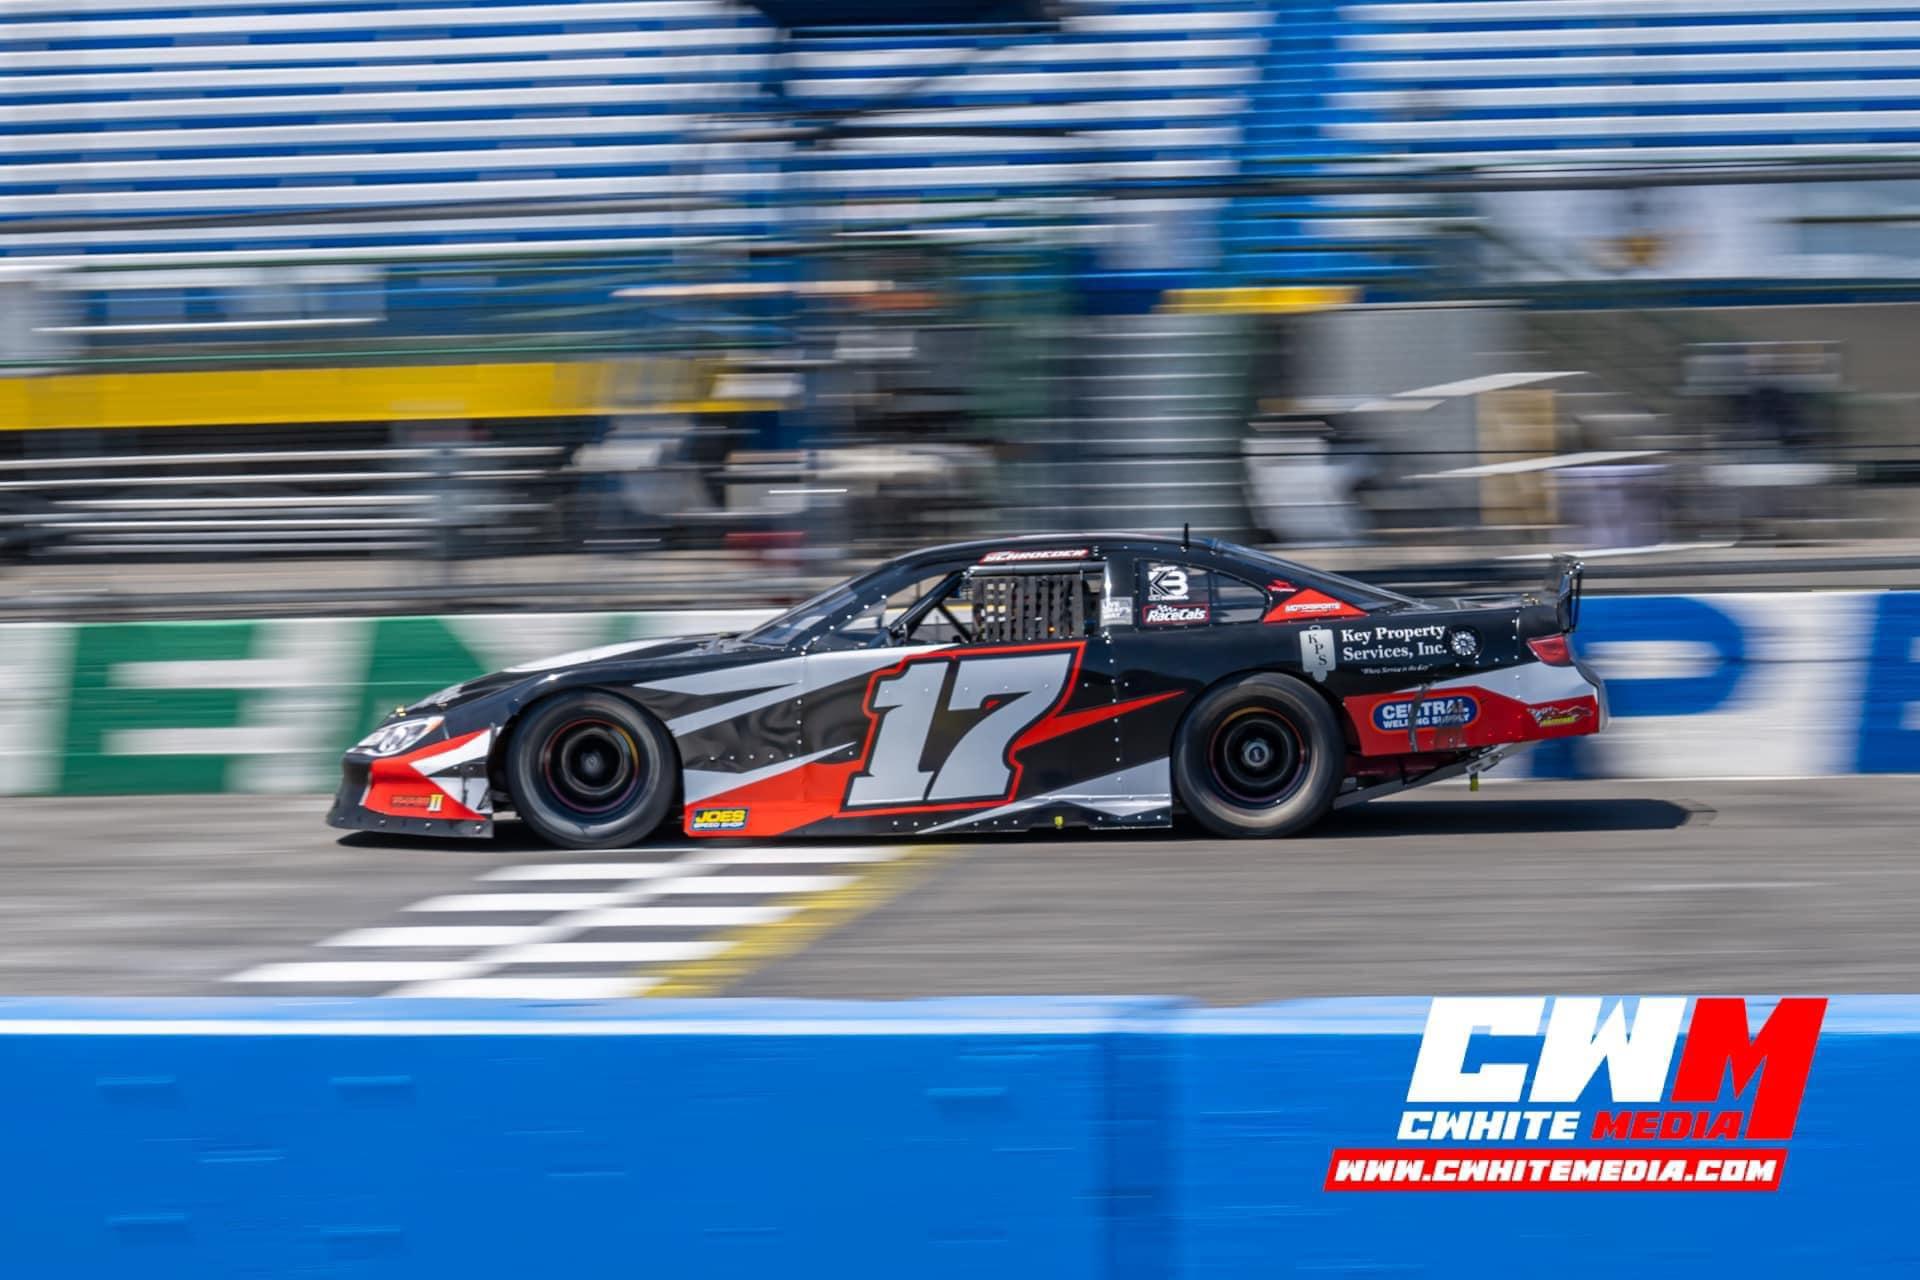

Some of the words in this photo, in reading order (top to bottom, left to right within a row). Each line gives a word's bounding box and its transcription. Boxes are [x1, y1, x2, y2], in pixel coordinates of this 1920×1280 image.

[1146, 606, 1206, 623] RaceCals
[1341, 629, 1371, 645] Key
[1375, 625, 1446, 642] Property
[1343, 644, 1413, 661] Services,
[1417, 641, 1447, 656] Inc.
[846, 653, 1073, 806] 17
[696, 810, 746, 822] JOES
